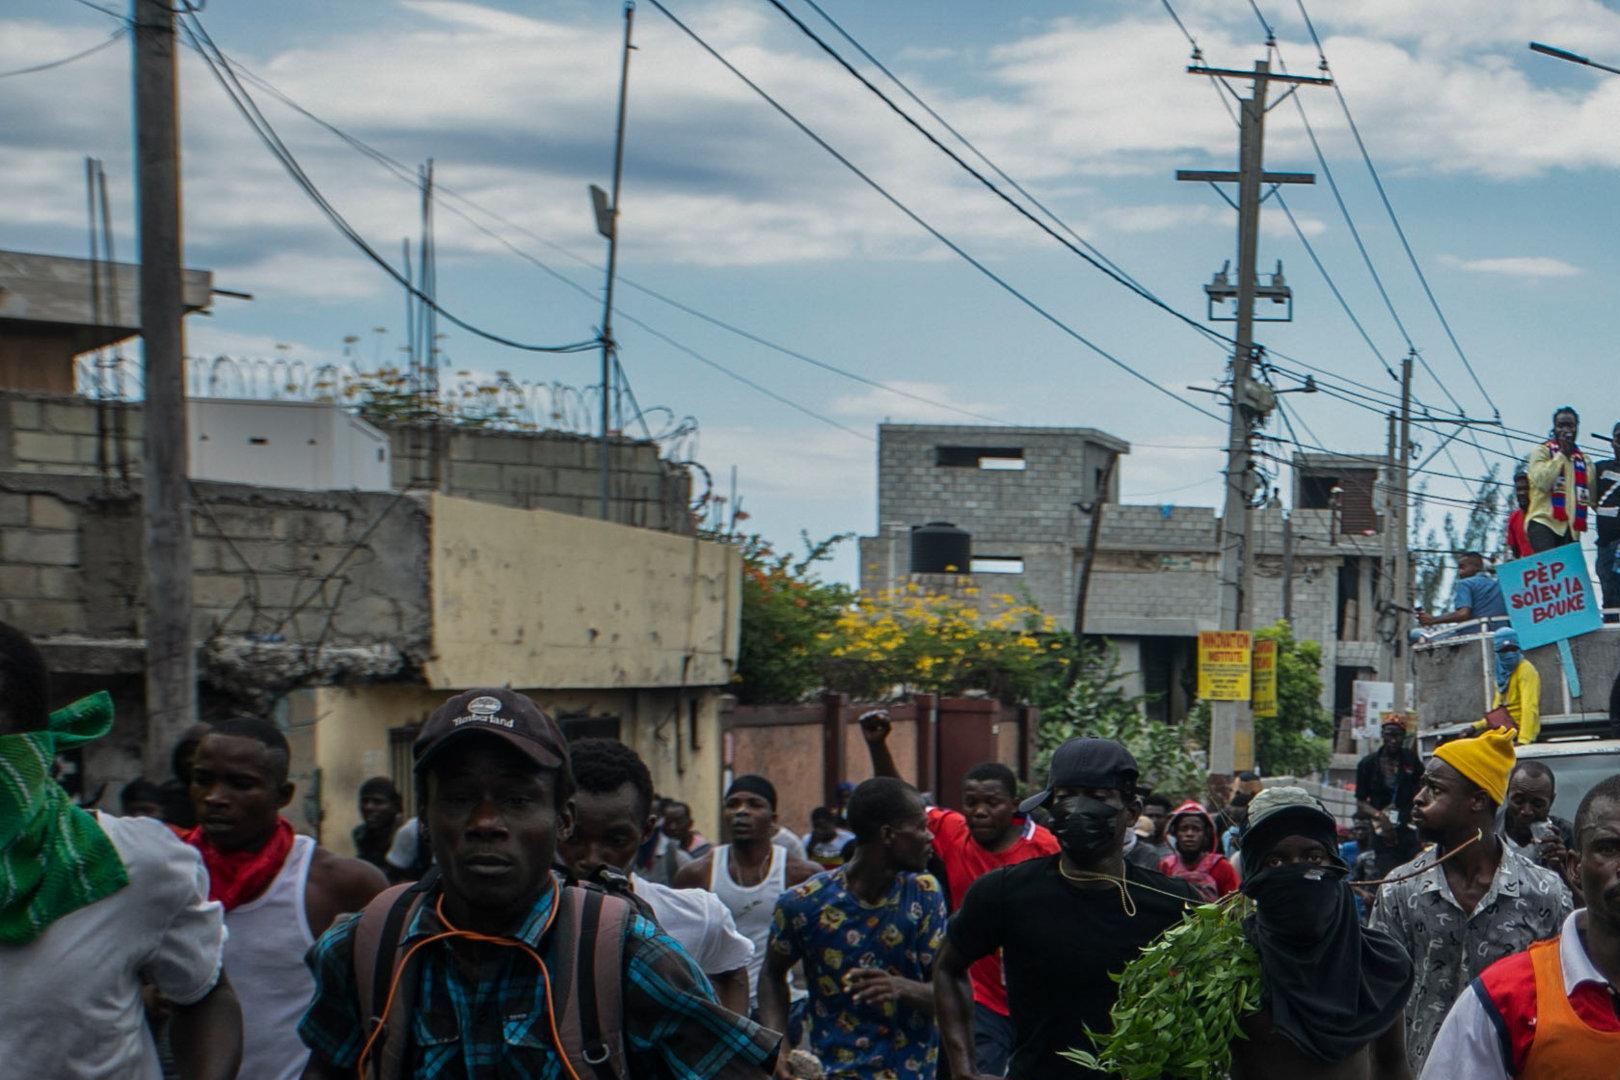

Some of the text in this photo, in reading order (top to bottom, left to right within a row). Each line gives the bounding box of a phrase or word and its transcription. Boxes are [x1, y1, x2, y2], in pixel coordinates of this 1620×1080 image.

[1523, 562, 1564, 588] PÈP
[1532, 594, 1585, 624] BOUKE
[452, 713, 514, 728] Timberland
